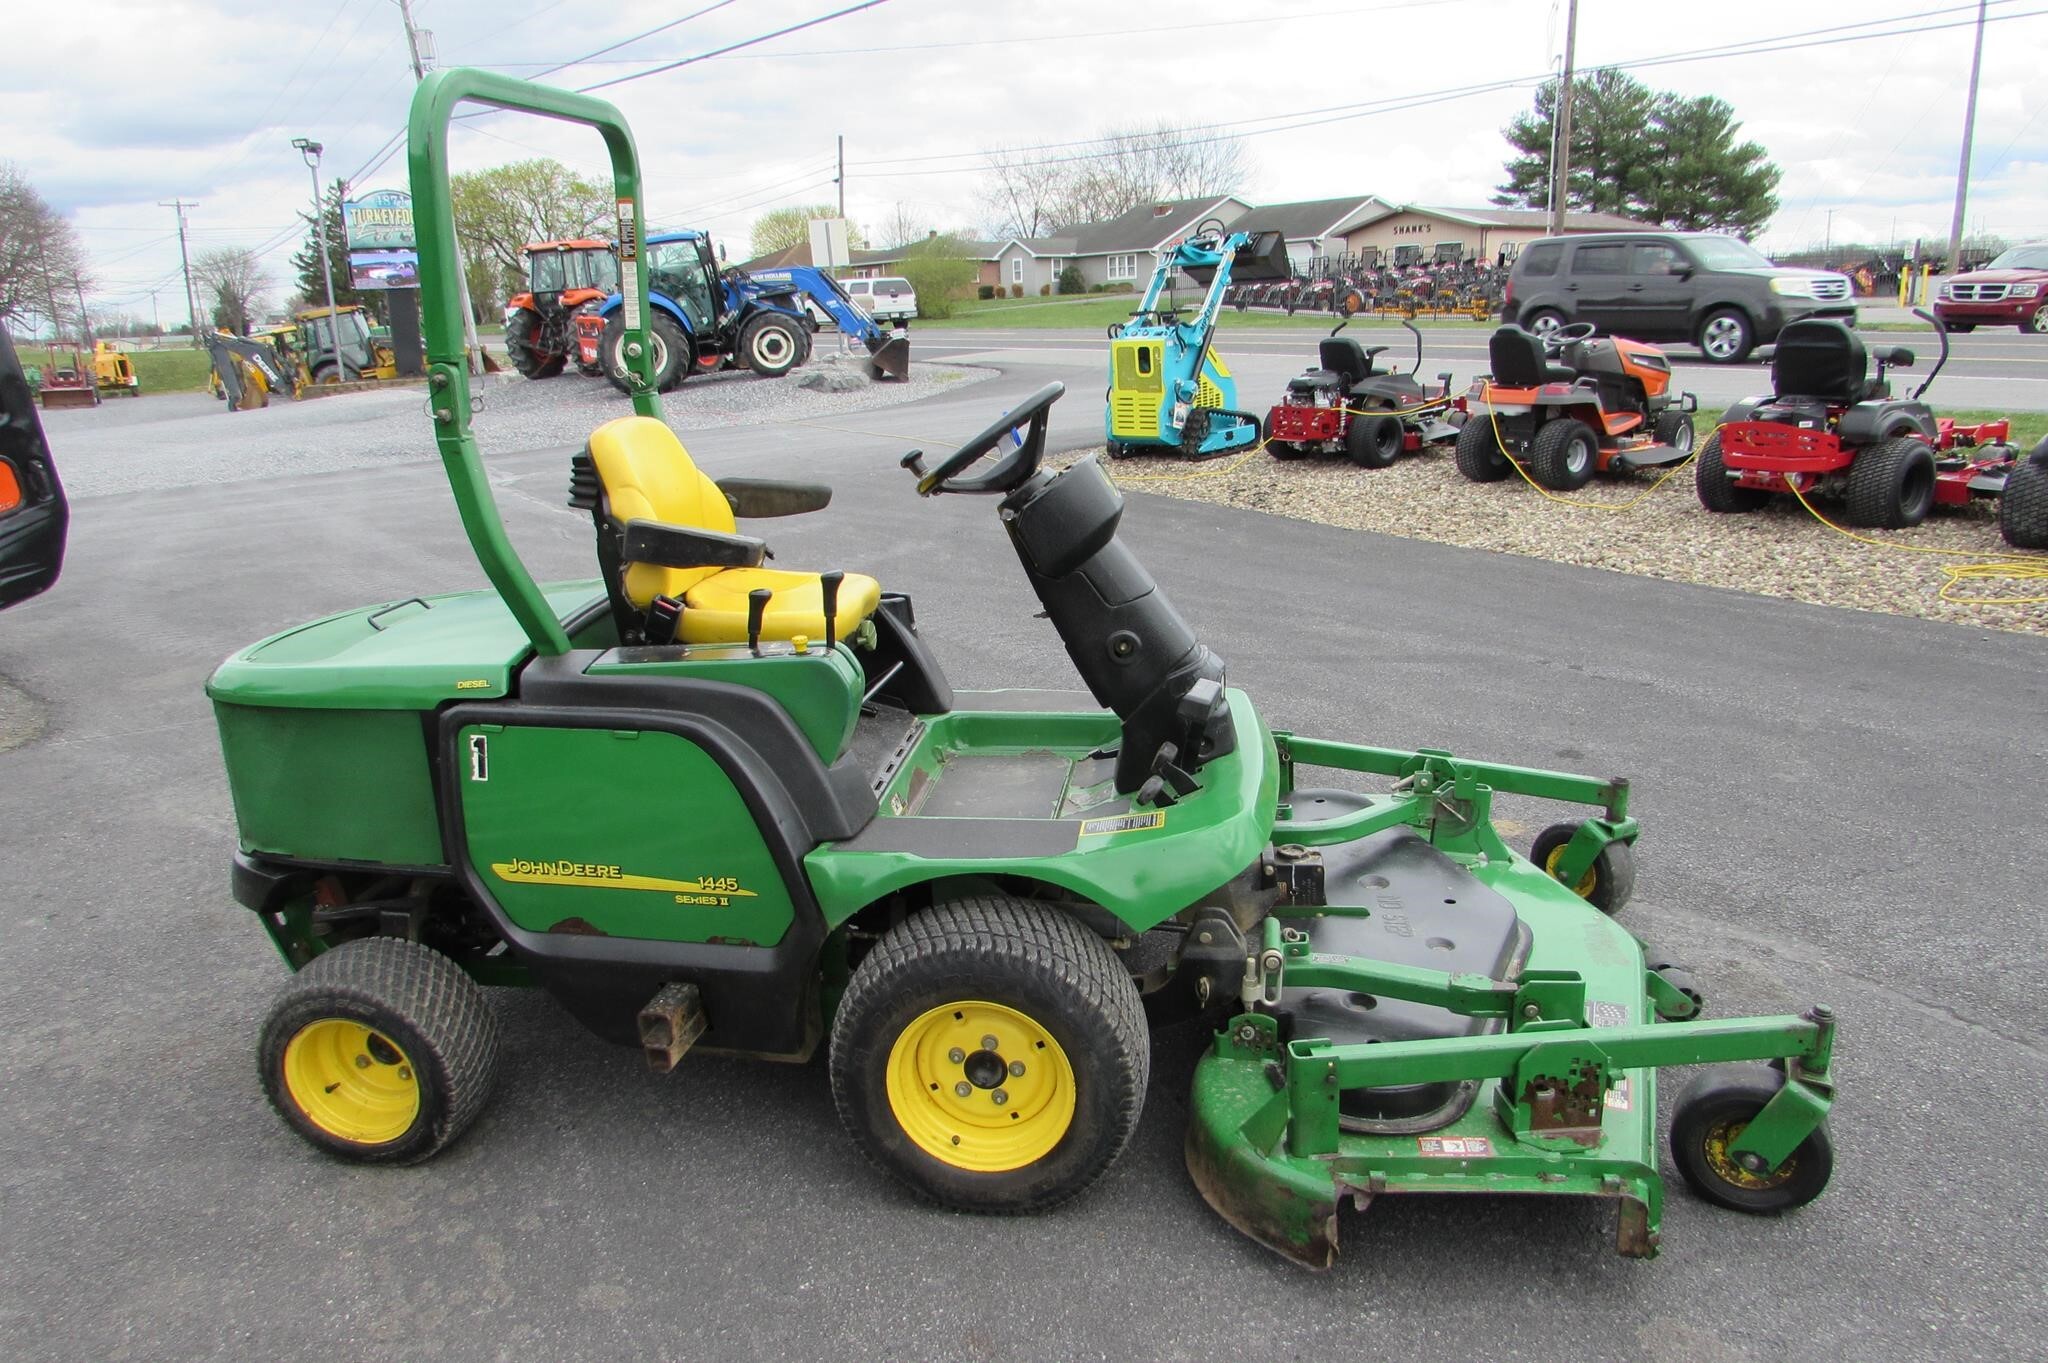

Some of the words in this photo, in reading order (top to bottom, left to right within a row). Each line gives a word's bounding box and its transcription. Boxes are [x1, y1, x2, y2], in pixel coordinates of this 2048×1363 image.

[351, 208, 414, 226] TURKEYFO
[1393, 224, 1431, 235] SHANK'S
[764, 272, 792, 280] HOLLAND
[252, 353, 279, 383] DEERE
[457, 680, 491, 689] DIESEL
[508, 858, 559, 875] JOHN
[558, 860, 623, 879] DEERE
[697, 876, 739, 891] 1445
[675, 894, 718, 906] SERIES
[719, 896, 729, 906] II
